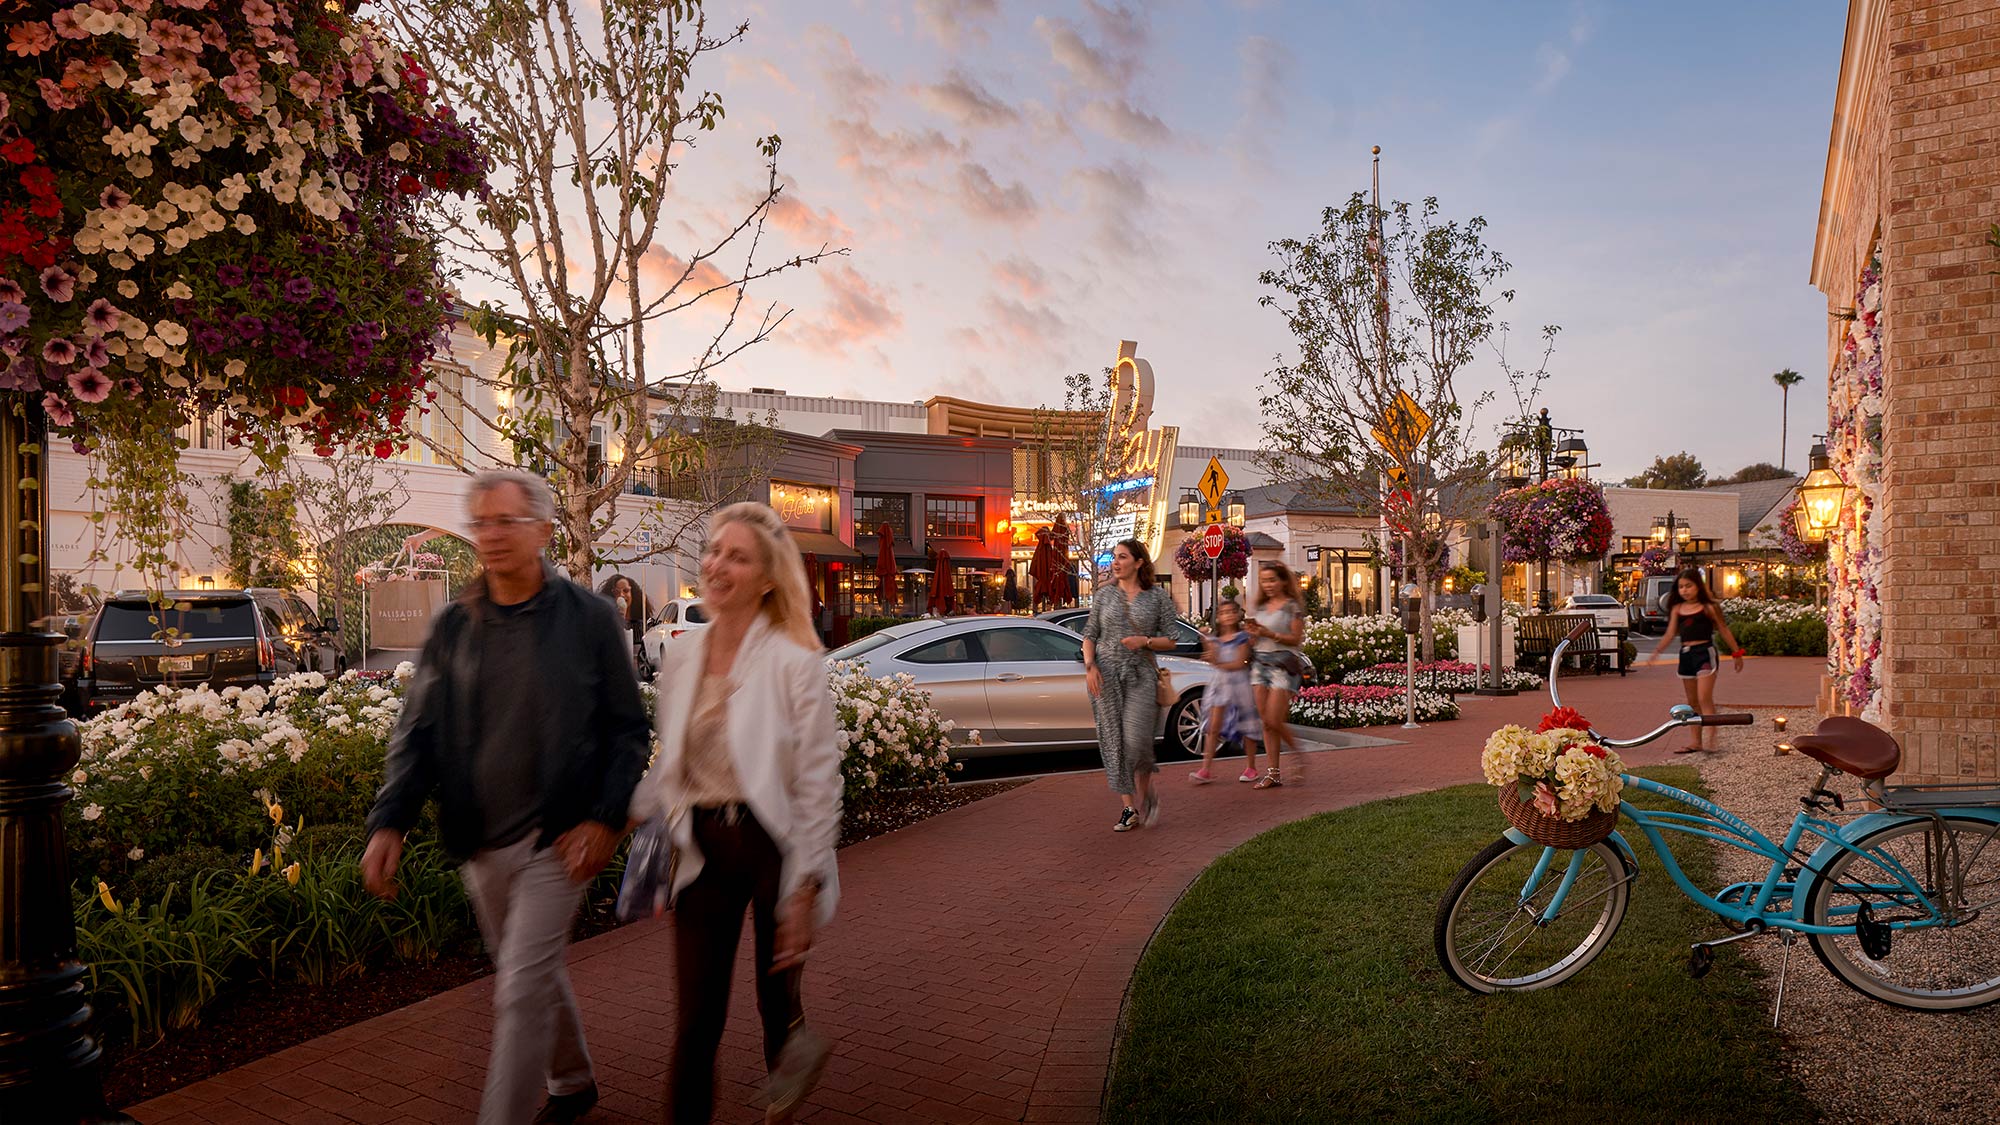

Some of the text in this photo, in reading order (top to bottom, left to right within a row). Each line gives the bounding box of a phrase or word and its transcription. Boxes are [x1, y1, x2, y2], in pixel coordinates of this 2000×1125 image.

[1205, 534, 1223, 548] STOP
[1656, 785, 1754, 837] PALISADES VILLAGE
